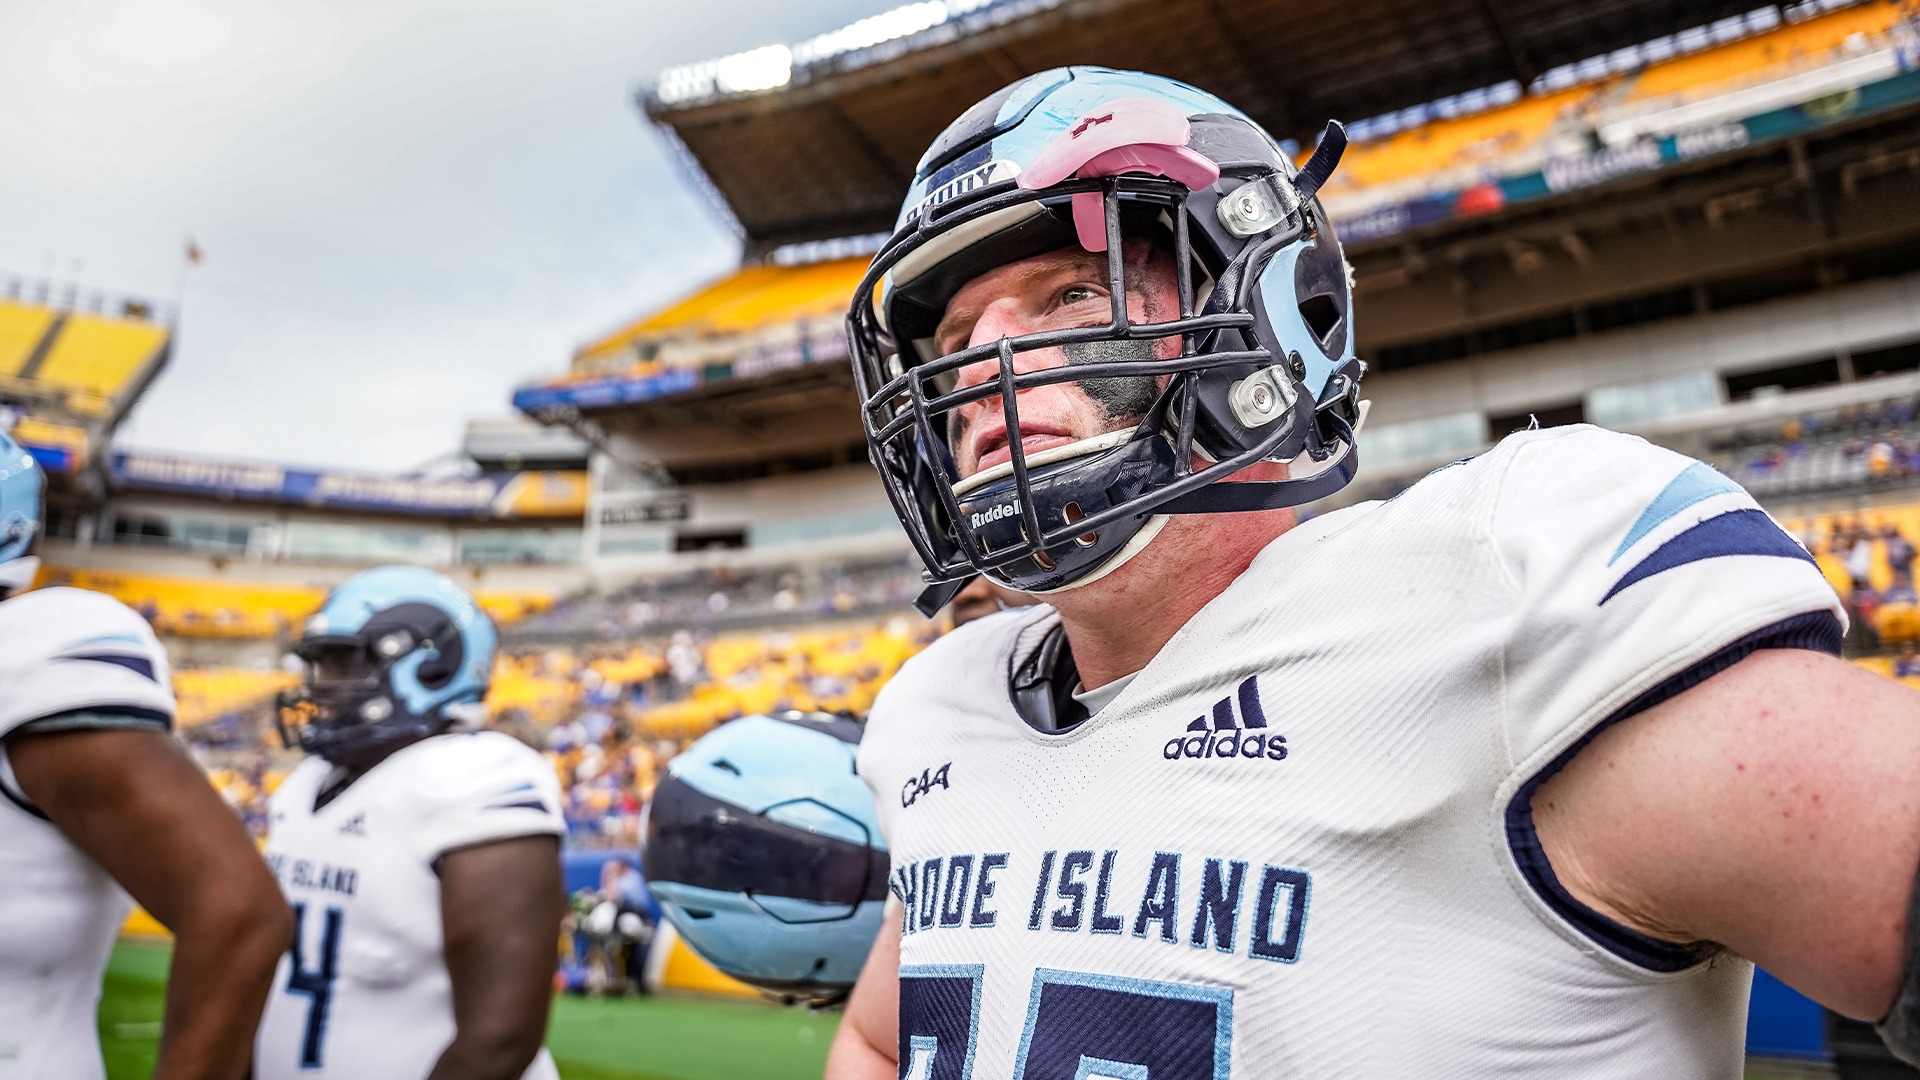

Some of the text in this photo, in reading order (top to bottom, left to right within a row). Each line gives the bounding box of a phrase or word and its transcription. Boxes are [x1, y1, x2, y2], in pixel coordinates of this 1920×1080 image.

[901, 761, 952, 808] CAA
[1163, 728, 1288, 761] adidas
[889, 849, 1312, 964] HODE ISLAND
[284, 902, 343, 1068] 4
